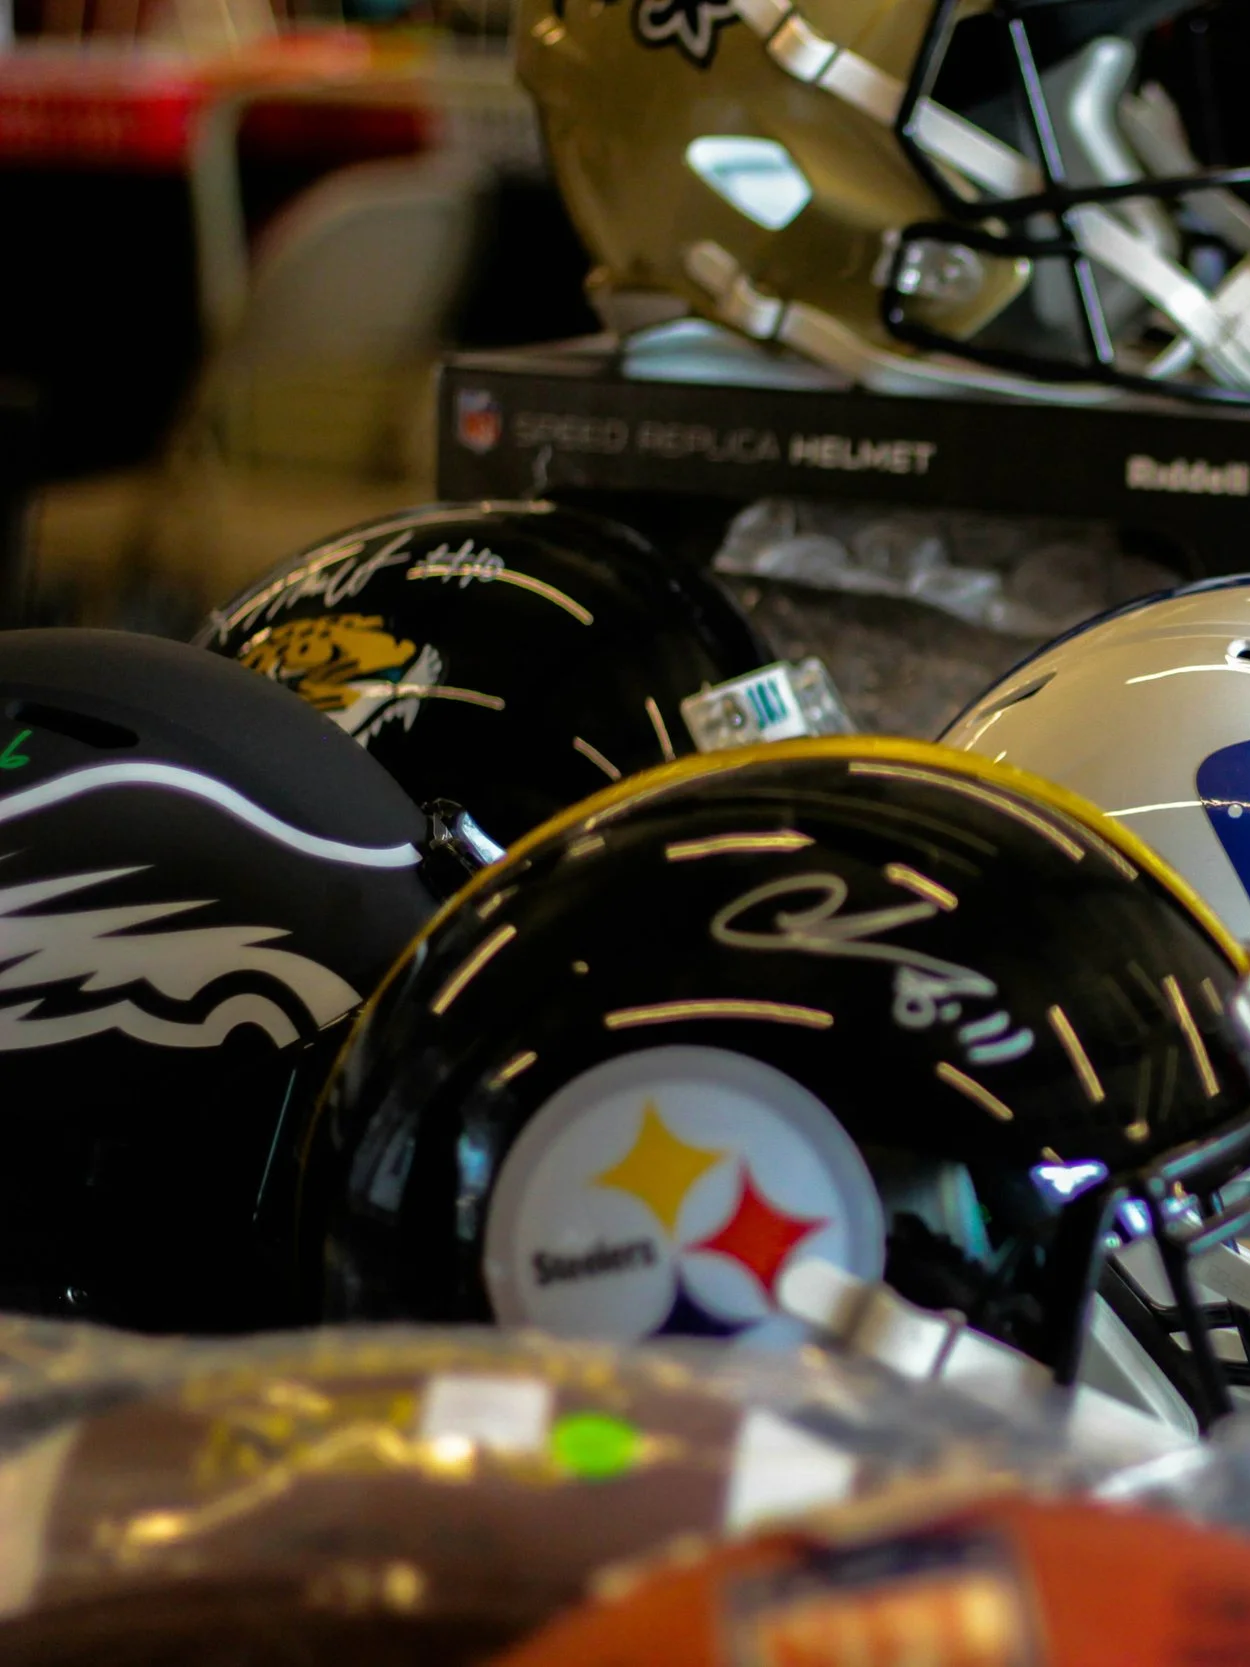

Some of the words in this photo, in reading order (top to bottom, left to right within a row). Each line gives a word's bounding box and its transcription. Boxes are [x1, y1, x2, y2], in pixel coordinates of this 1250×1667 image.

[634, 418, 783, 464] REPLICA
[788, 430, 937, 476] HELMET
[533, 1239, 658, 1287] Steelers
